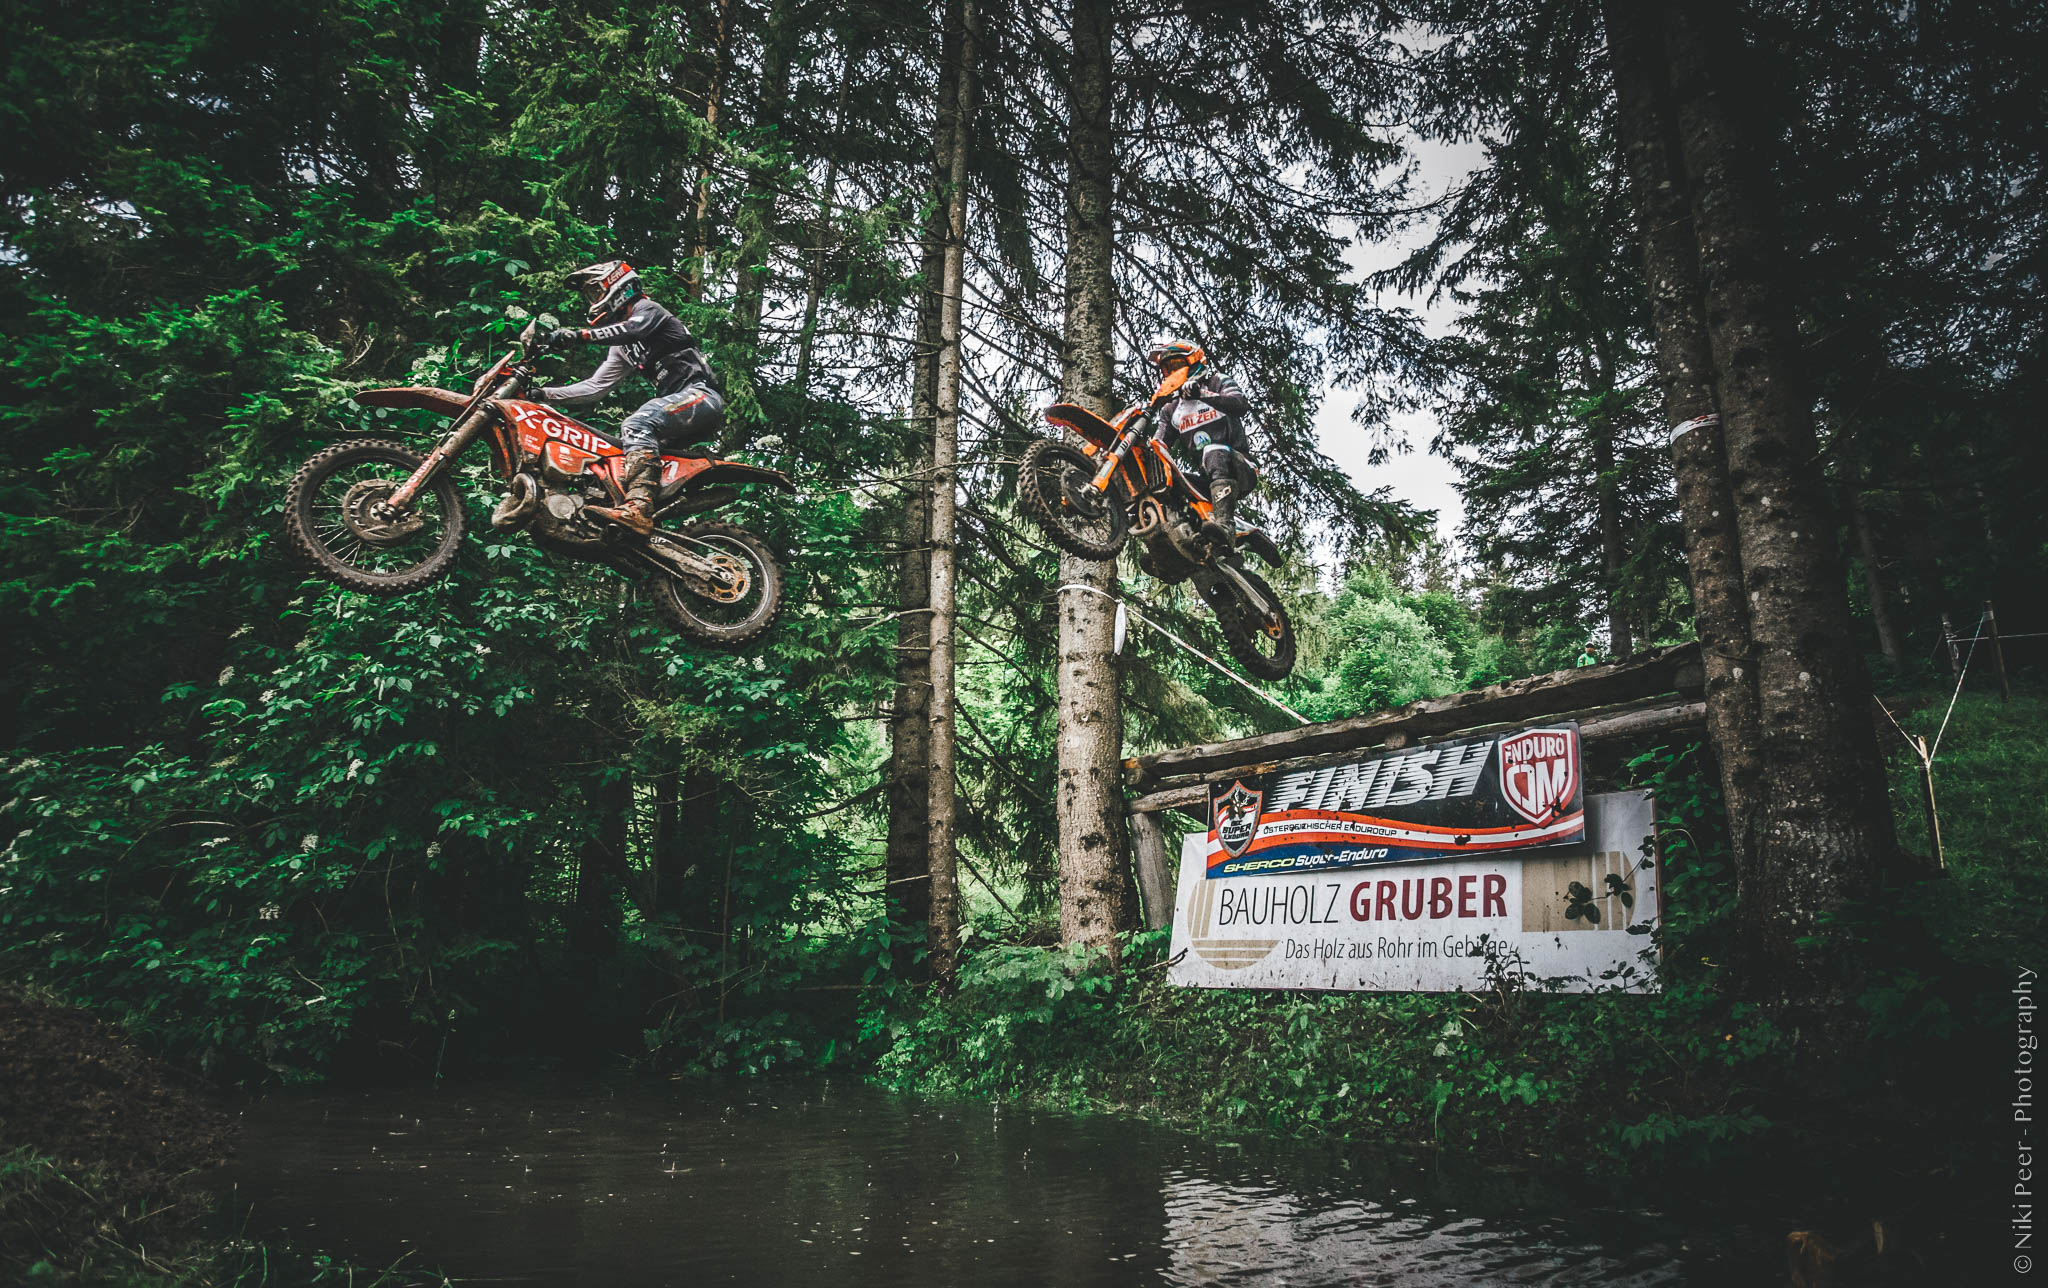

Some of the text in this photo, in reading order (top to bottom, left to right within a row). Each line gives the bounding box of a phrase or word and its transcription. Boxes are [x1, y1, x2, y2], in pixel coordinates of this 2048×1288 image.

[590, 323, 628, 341] LEATT
[511, 404, 613, 453] X-GRIP
[1178, 409, 1217, 431] WALZER
[1504, 736, 1565, 764] ENDURO
[1266, 740, 1495, 813] FINISH
[1222, 822, 1252, 834] SUPER
[1223, 857, 1296, 874] SHERCO
[1218, 873, 1508, 926] BAUHOLZ GRUBER
[1285, 938, 1310, 959] Das
[1313, 937, 1345, 959] Holz
[1348, 943, 1373, 959] aus
[1378, 936, 1413, 959] Rohr
[1417, 937, 1437, 958] im
